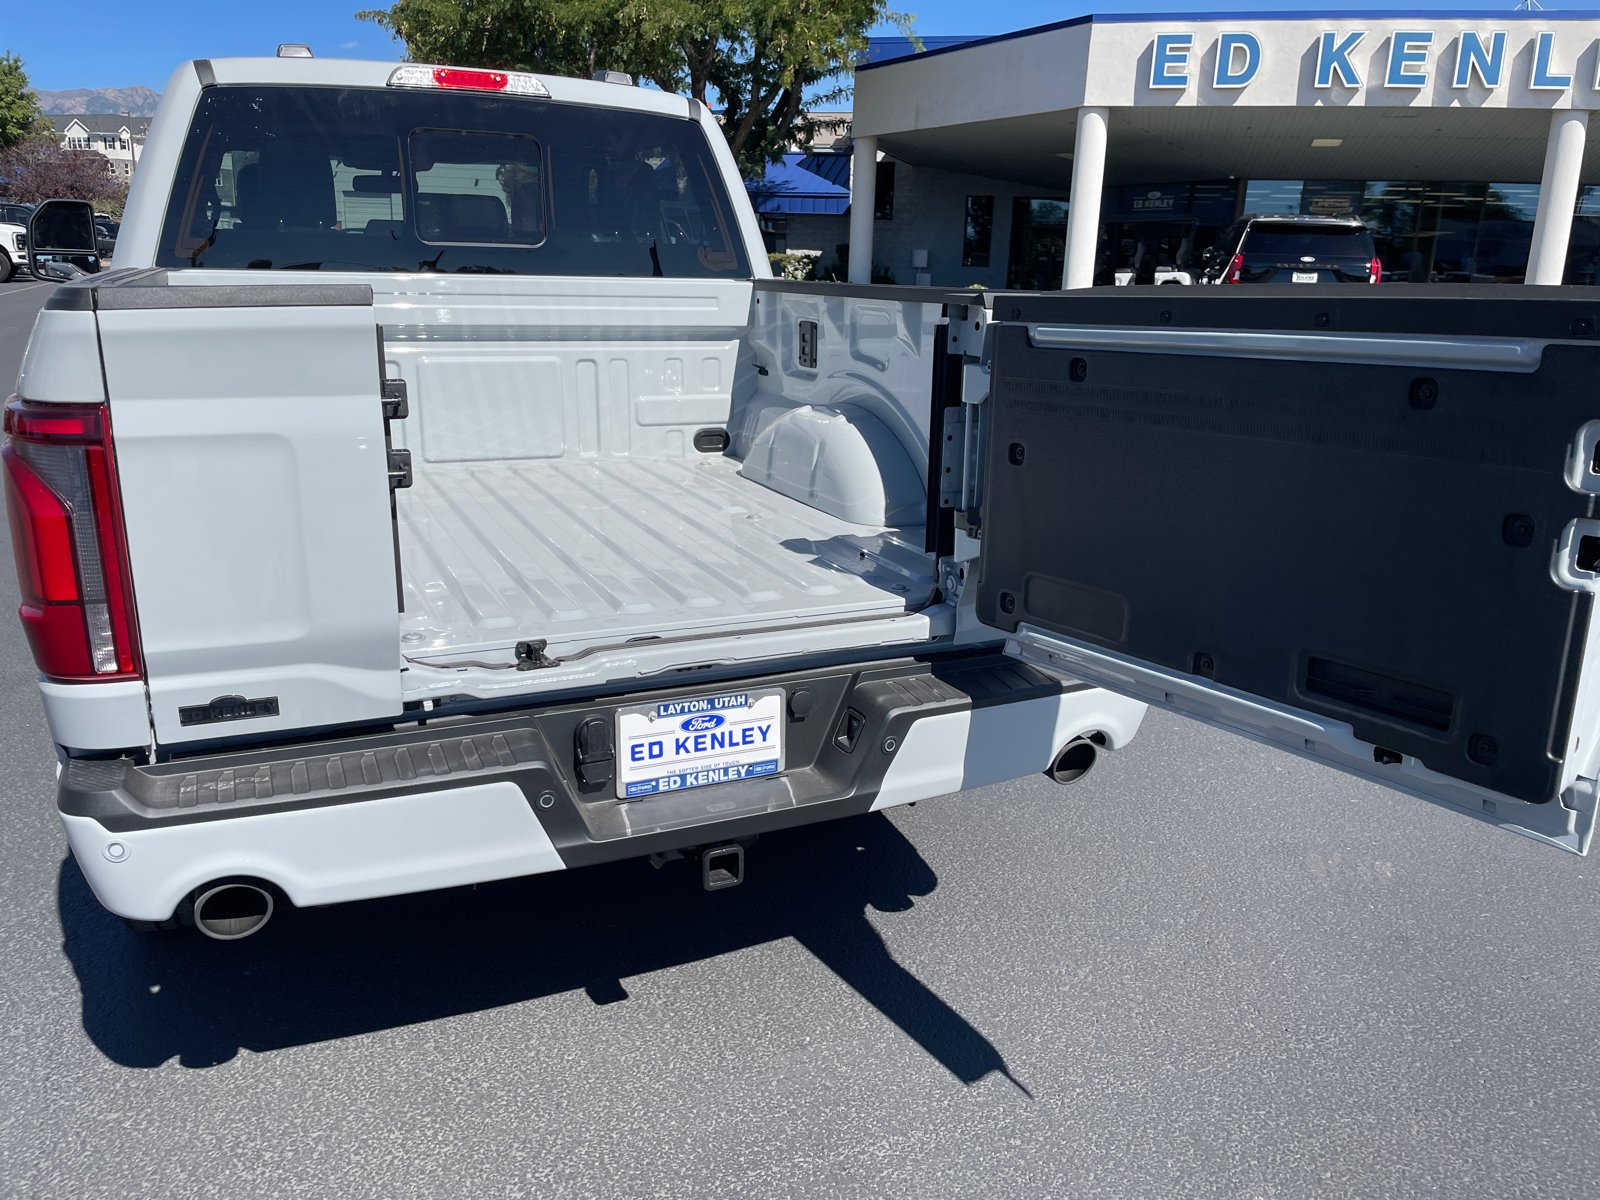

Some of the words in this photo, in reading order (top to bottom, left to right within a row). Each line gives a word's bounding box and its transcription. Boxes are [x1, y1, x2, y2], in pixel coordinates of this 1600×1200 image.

[1149, 31, 1263, 90] ED
[1313, 29, 1600, 90] KENL
[1133, 200, 1143, 208] ED
[1144, 199, 1175, 208] KENLEY
[181, 710, 203, 722] ED
[209, 702, 276, 719] KENLEY
[660, 699, 711, 716] LAYTON,
[714, 695, 746, 709] UTAH
[688, 716, 717, 731] Ford
[630, 740, 664, 762] ED
[675, 724, 772, 756] KENLEY
[658, 776, 681, 791] ED
[686, 765, 749, 787] KENLEY
